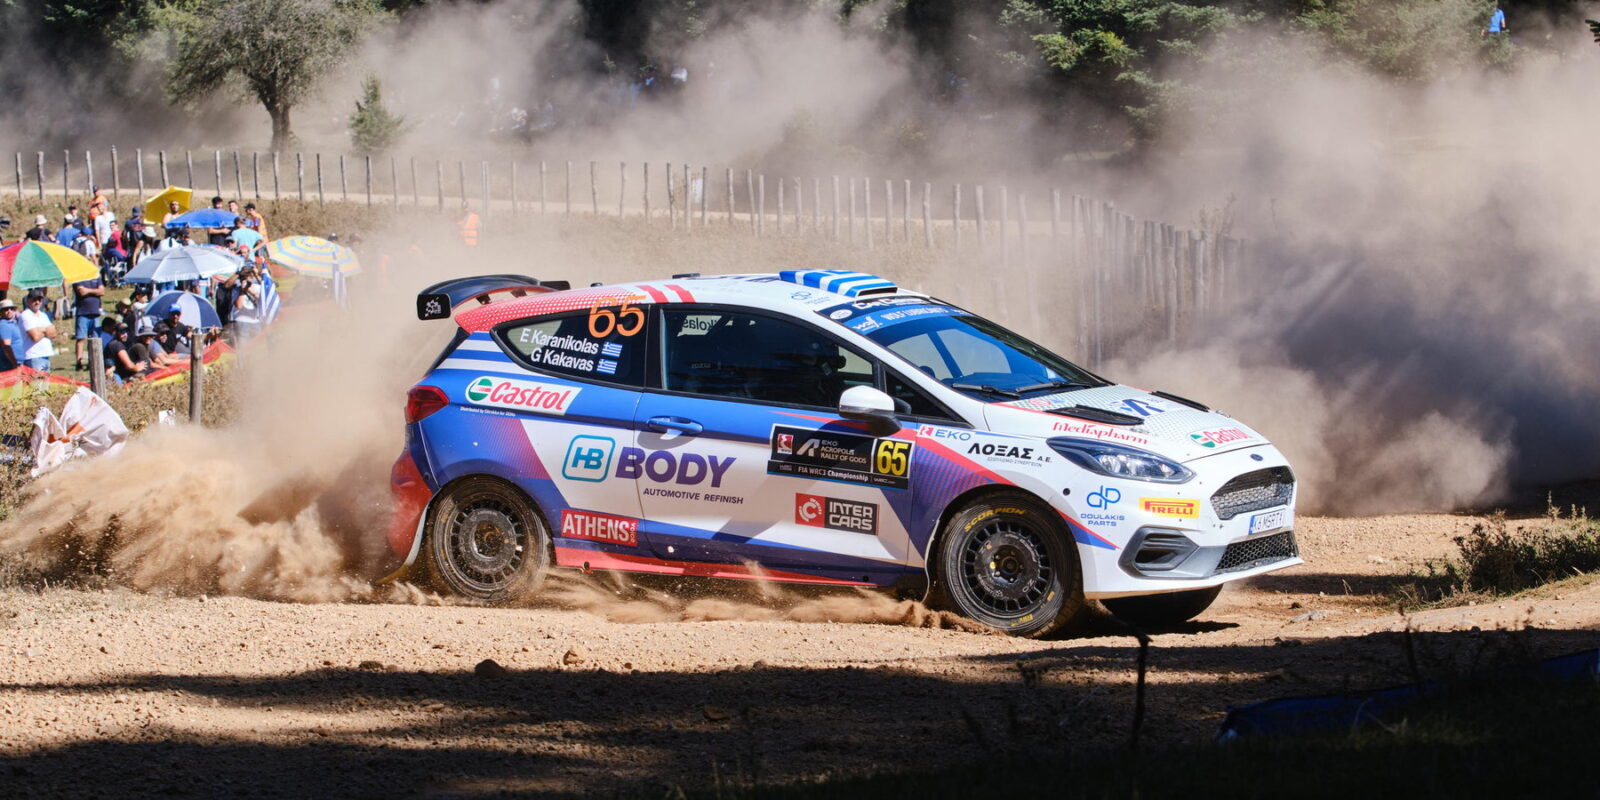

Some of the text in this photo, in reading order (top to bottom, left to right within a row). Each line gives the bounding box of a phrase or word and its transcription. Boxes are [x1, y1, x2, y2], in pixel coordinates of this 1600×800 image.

[588, 294, 646, 338] 65
[520, 327, 599, 355] E Karanikolas
[530, 347, 594, 372] G Kakavas
[490, 381, 572, 411] Castrol
[935, 429, 971, 441] EKO
[1053, 422, 1147, 444] Mediapharm
[1202, 427, 1252, 444] Castrol
[571, 447, 604, 470] HB
[821, 452, 839, 460] RALLY
[877, 440, 909, 476] 65
[968, 443, 1034, 459] ΛΟΞΑΣ
[615, 446, 737, 488] BODY
[827, 469, 869, 482] Championship
[643, 487, 744, 505] AUTOMOTIVE REFINISH
[829, 501, 873, 518] INTER
[1080, 513, 1125, 521] DOULAKIS
[1145, 501, 1194, 515] PIRELLI
[562, 513, 630, 542] ATHENS
[829, 514, 873, 531] CARS
[964, 507, 1027, 532] SCORPION
